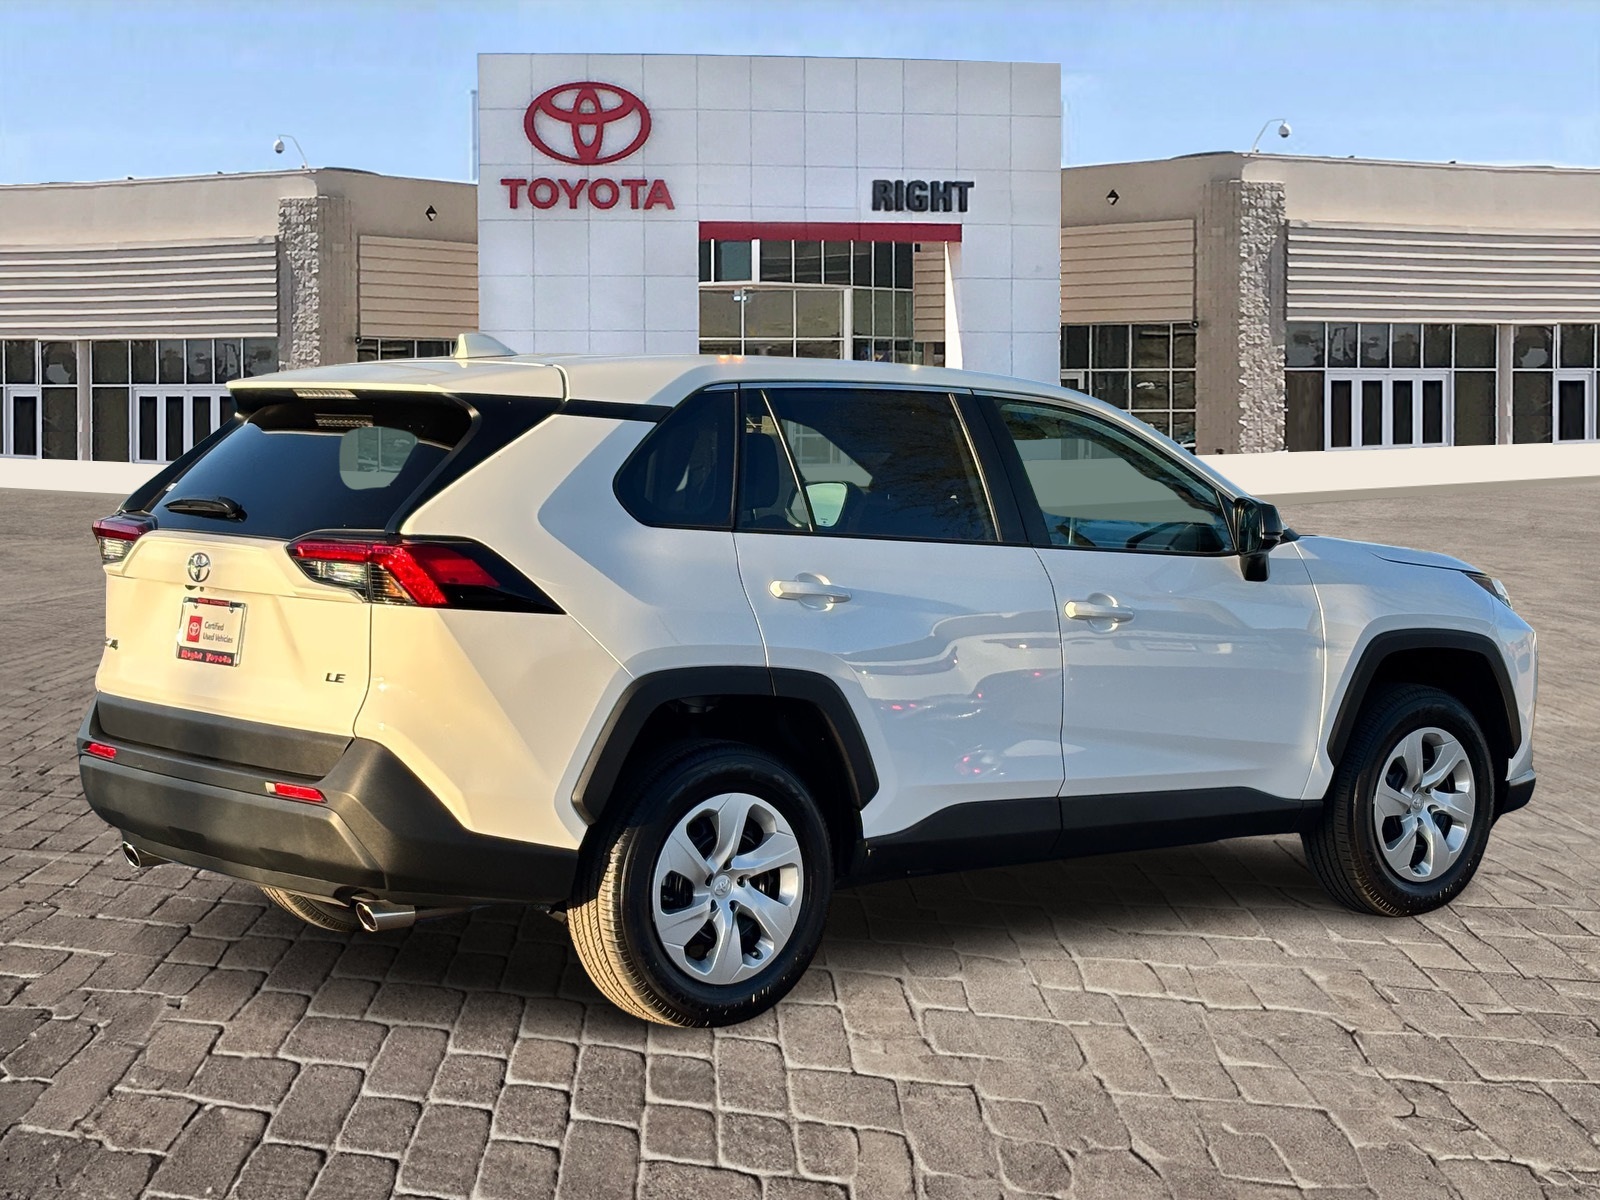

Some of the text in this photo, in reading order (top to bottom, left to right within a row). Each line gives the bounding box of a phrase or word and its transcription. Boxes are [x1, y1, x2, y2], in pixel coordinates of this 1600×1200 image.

[501, 178, 675, 210] TOYOTA
[872, 179, 975, 213] RIGHT
[204, 621, 225, 631] Certified
[202, 632, 233, 644] Used Vehicles
[206, 652, 232, 664] Toyota
[325, 672, 346, 684] LE
